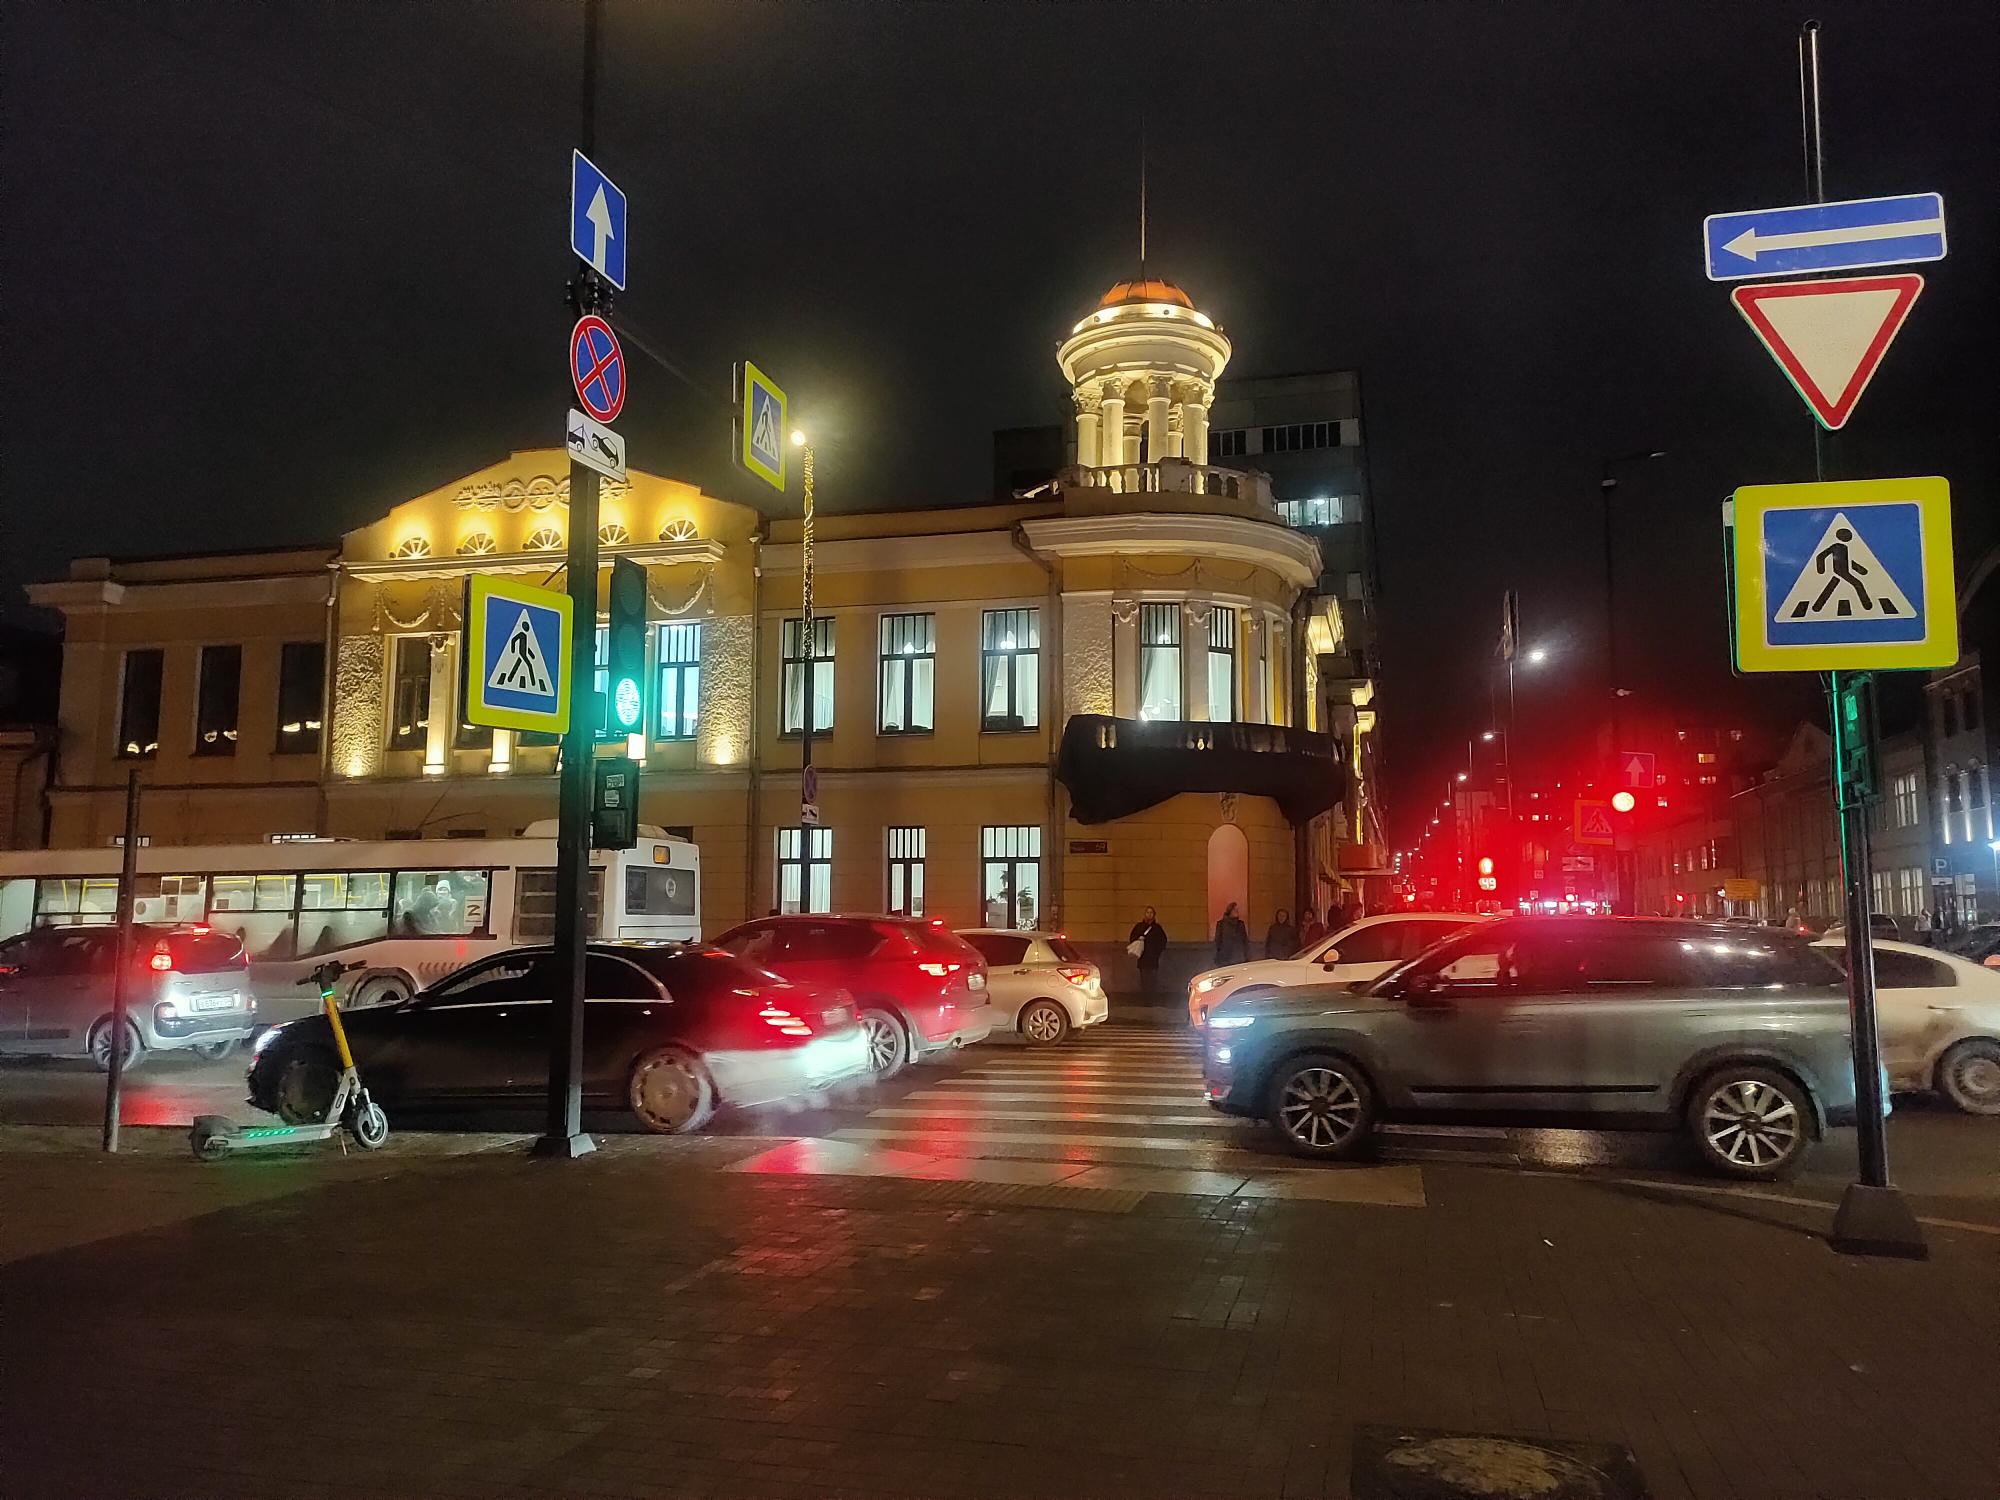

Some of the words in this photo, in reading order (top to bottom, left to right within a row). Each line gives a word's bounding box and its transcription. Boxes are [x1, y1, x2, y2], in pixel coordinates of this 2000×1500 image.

[1935, 859, 1947, 873] P
[1480, 877, 1496, 890] 49
[467, 904, 481, 916] Z
